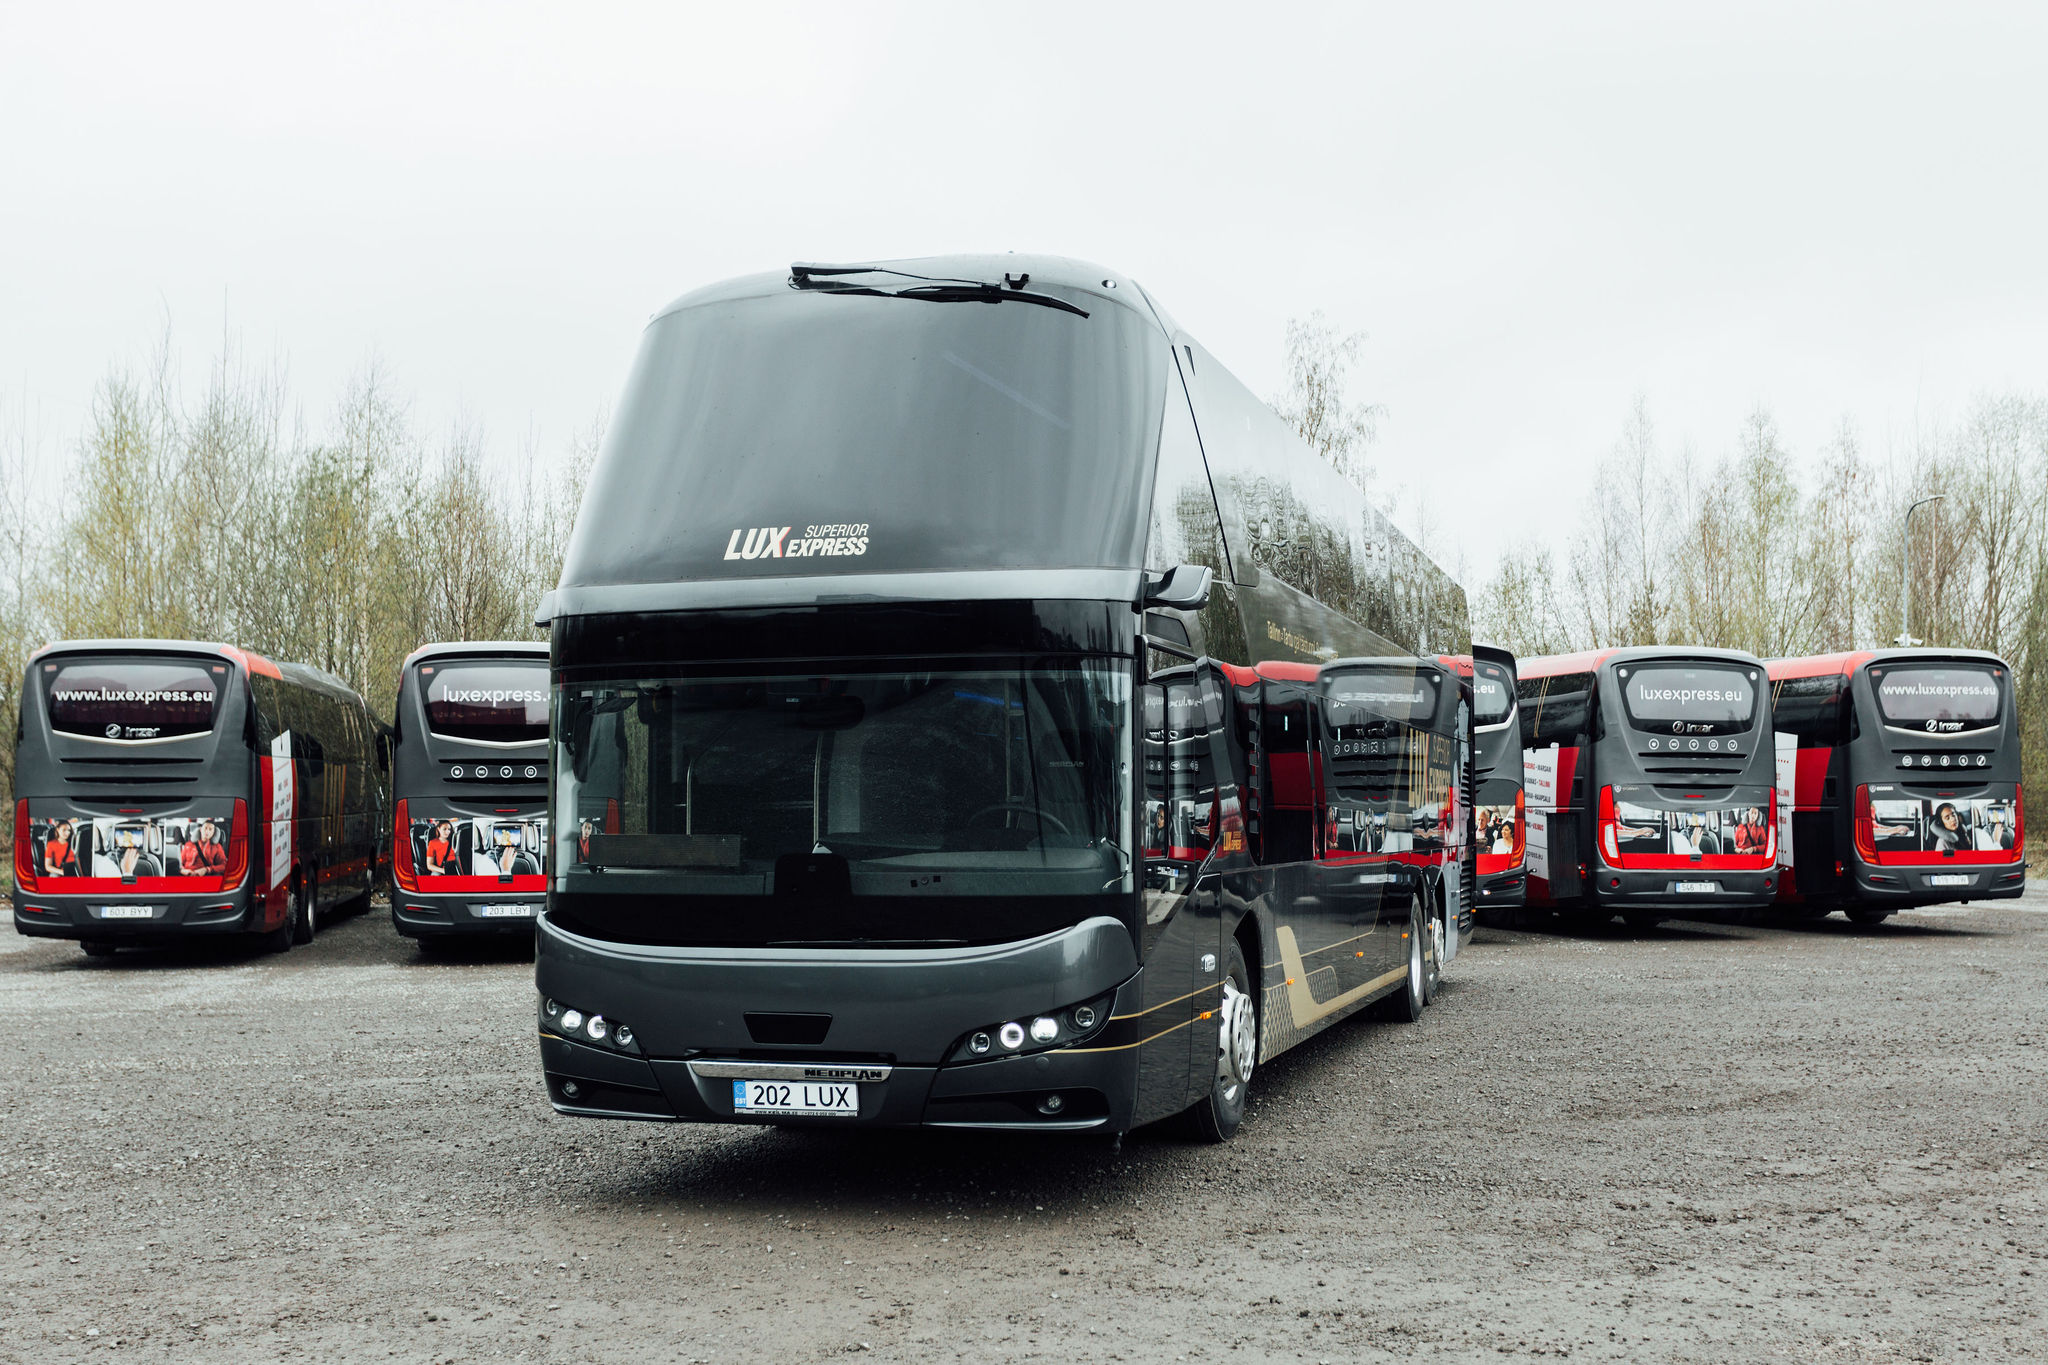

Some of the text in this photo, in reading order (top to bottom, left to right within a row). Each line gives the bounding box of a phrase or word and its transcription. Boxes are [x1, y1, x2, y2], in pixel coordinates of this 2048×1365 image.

[804, 523, 869, 538] SUPERIOR
[723, 526, 870, 561] LUX EXPRESS
[55, 686, 213, 705] www.luxexpress.eu
[443, 684, 551, 708] luxexpress.
[1473, 684, 1495, 694] .eu
[1640, 685, 1742, 705] luxexpress.eu
[1883, 683, 1996, 698] www.luxexpress.eu
[1408, 727, 1429, 810] LUX
[489, 906, 528, 915] 203 LBY
[804, 1069, 882, 1080] NEOPLAN
[734, 1097, 747, 1105] EST
[753, 1084, 850, 1108] 202 LUX
